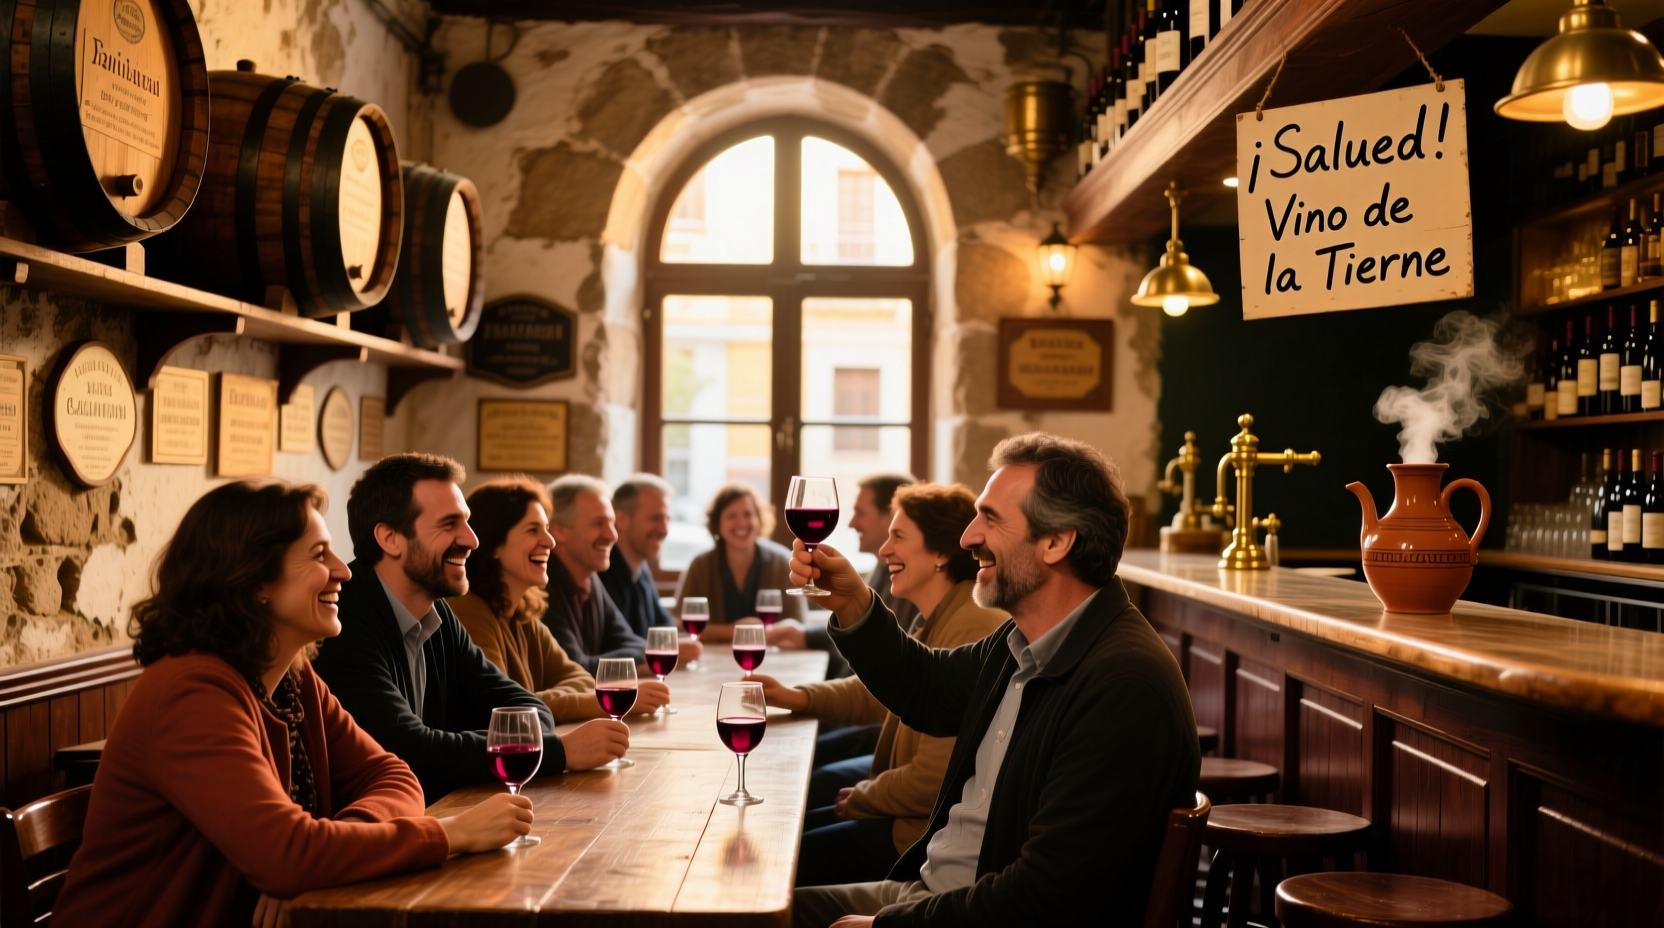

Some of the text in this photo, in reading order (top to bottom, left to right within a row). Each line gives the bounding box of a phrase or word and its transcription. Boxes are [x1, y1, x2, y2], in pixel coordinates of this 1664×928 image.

[1248, 101, 1450, 194] ¡Salued!
[1265, 182, 1414, 242] Vino de
[1265, 242, 1451, 295] la Tierne
